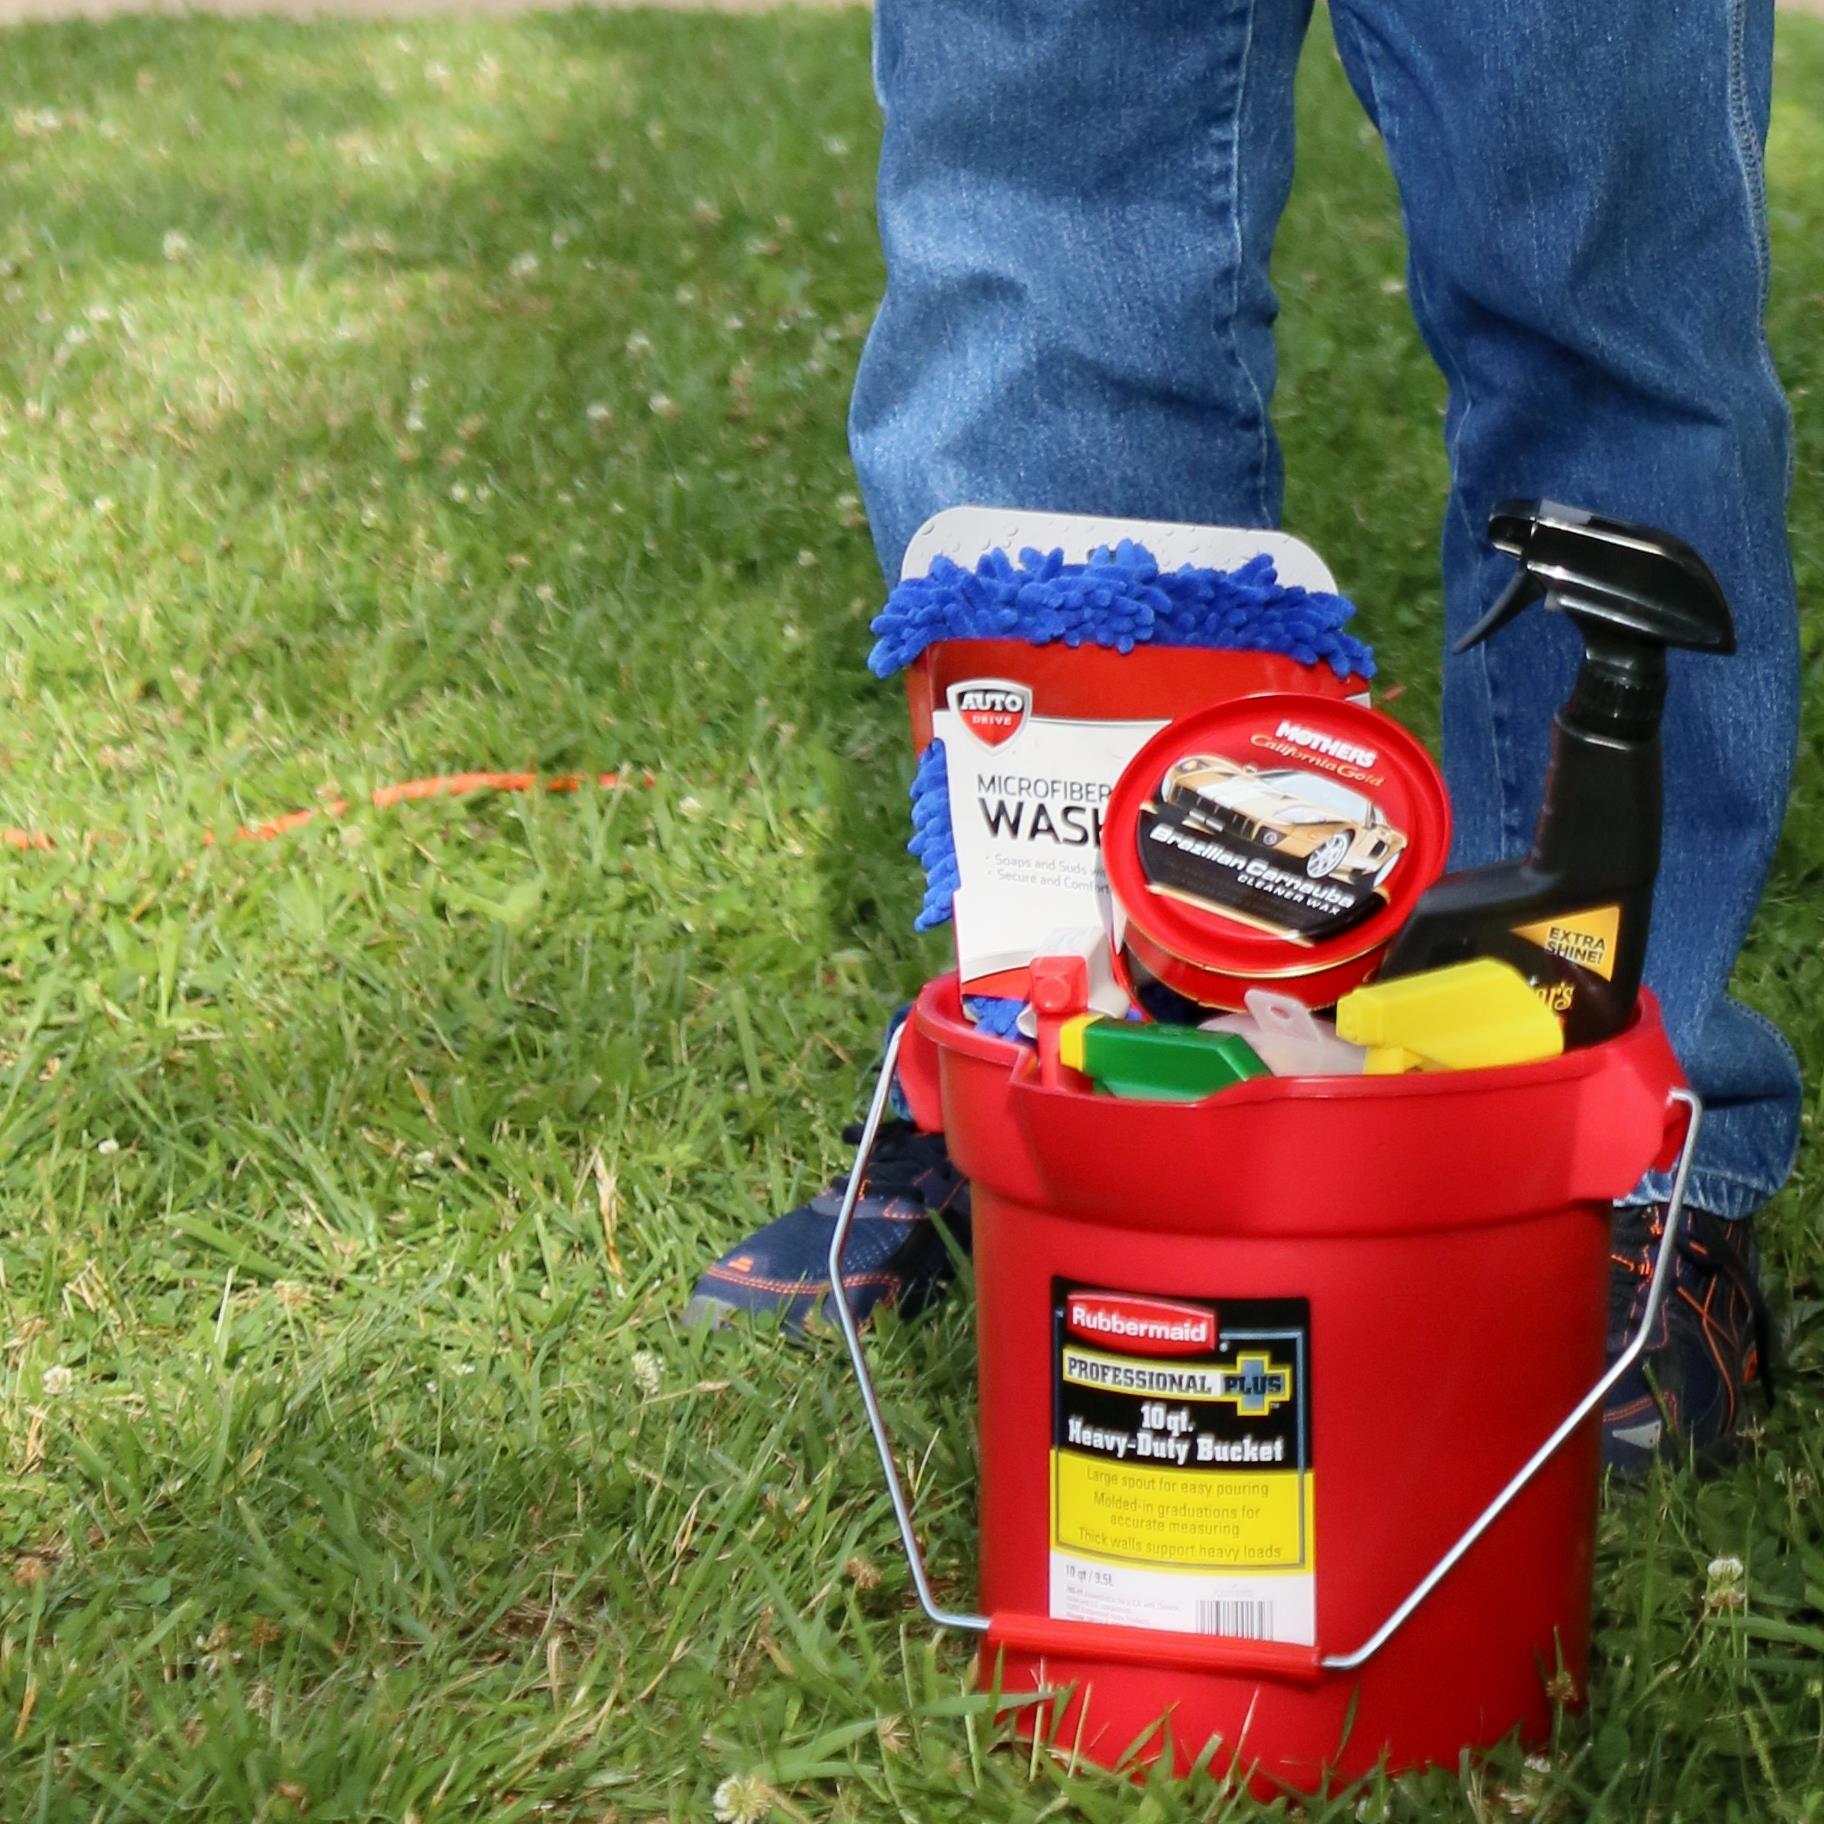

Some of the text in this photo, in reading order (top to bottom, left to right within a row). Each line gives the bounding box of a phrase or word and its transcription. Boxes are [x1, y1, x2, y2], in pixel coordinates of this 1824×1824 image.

[960, 691, 1024, 712] AUTO
[972, 714, 1012, 726] DRIVE
[1275, 719, 1377, 769] MOTHERS
[1250, 734, 1385, 787] California Gold
[977, 773, 1112, 803] MICROFIBER
[995, 853, 1031, 868] Soaps
[1034, 859, 1056, 871] and
[1059, 859, 1088, 875] Suds
[997, 868, 1038, 883] Secure
[1040, 875, 1061, 887] and
[1150, 822, 1356, 909] Brazilian Carnauba
[1237, 873, 1342, 916] CLEANER WAX
[1545, 940, 1604, 965] SHINE!
[1549, 927, 1606, 951] EXTRA
[1071, 1305, 1207, 1343] Rubbermaid
[1067, 1355, 1282, 1395] PROFESSIONAL PLUS
[1068, 1414, 1284, 1466] Heavy-Duty Bucket
[1086, 1465, 1269, 1499] Large spout for easy pouring
[1093, 1490, 1262, 1520] Molded-in graduations for
[1110, 1512, 1240, 1539] accurate measuring
[1078, 1526, 1281, 1560] Thick walls support heavy loads
